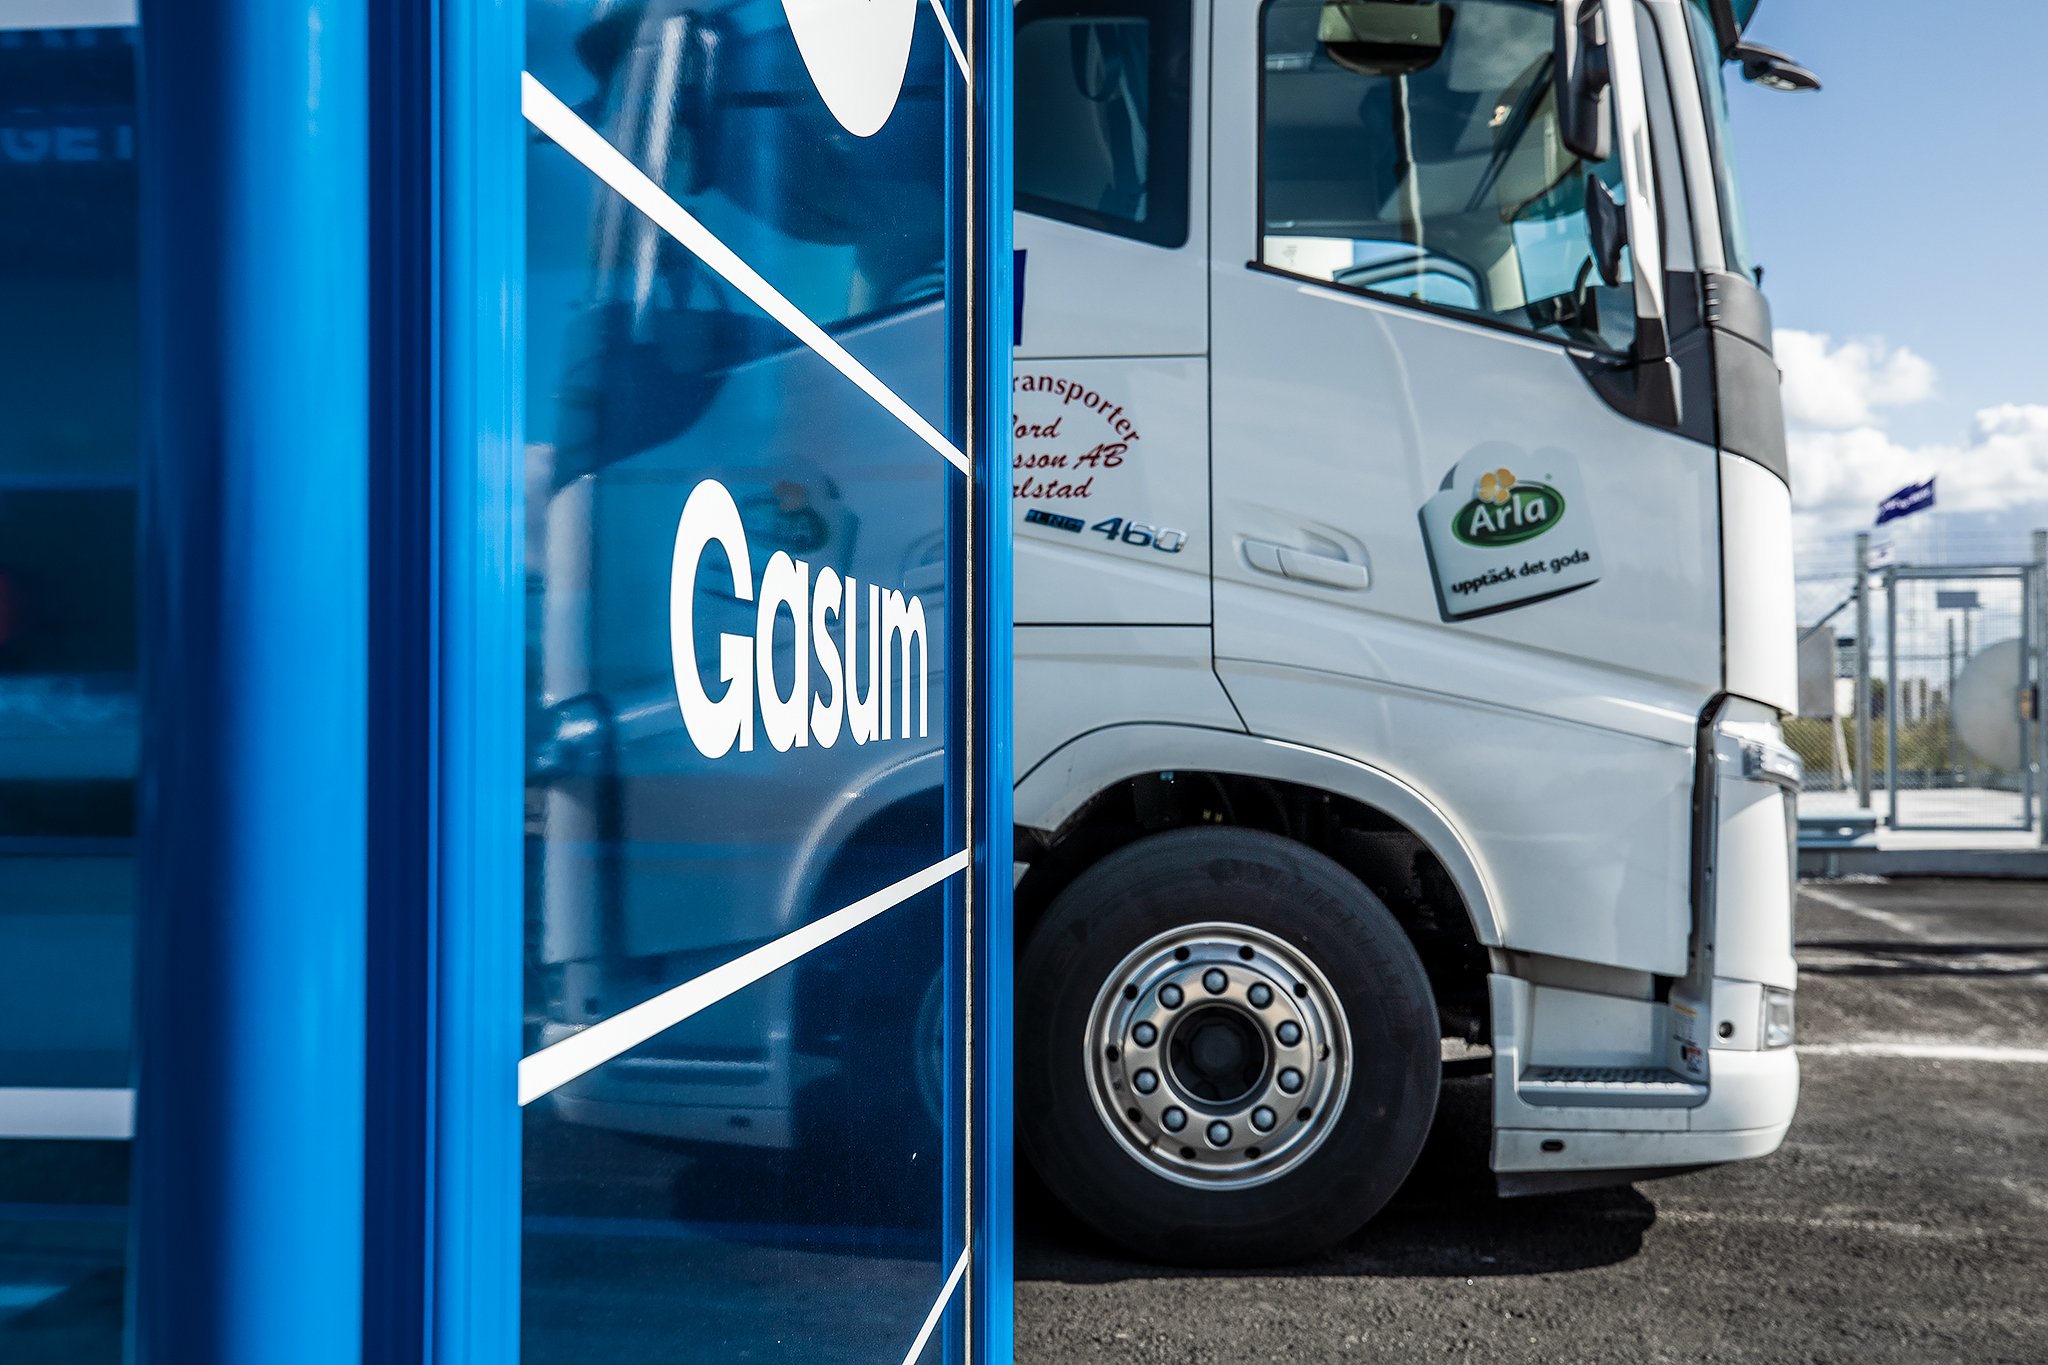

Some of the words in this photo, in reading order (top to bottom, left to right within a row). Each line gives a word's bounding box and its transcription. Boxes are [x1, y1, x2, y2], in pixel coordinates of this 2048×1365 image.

[1072, 443, 1128, 469] AB
[1091, 517, 1189, 553] 460
[1469, 494, 1546, 536] Arla
[1451, 566, 1517, 595] upptäck
[1519, 561, 1547, 576] det
[1550, 549, 1590, 574] goda
[670, 478, 928, 759] Gasum
